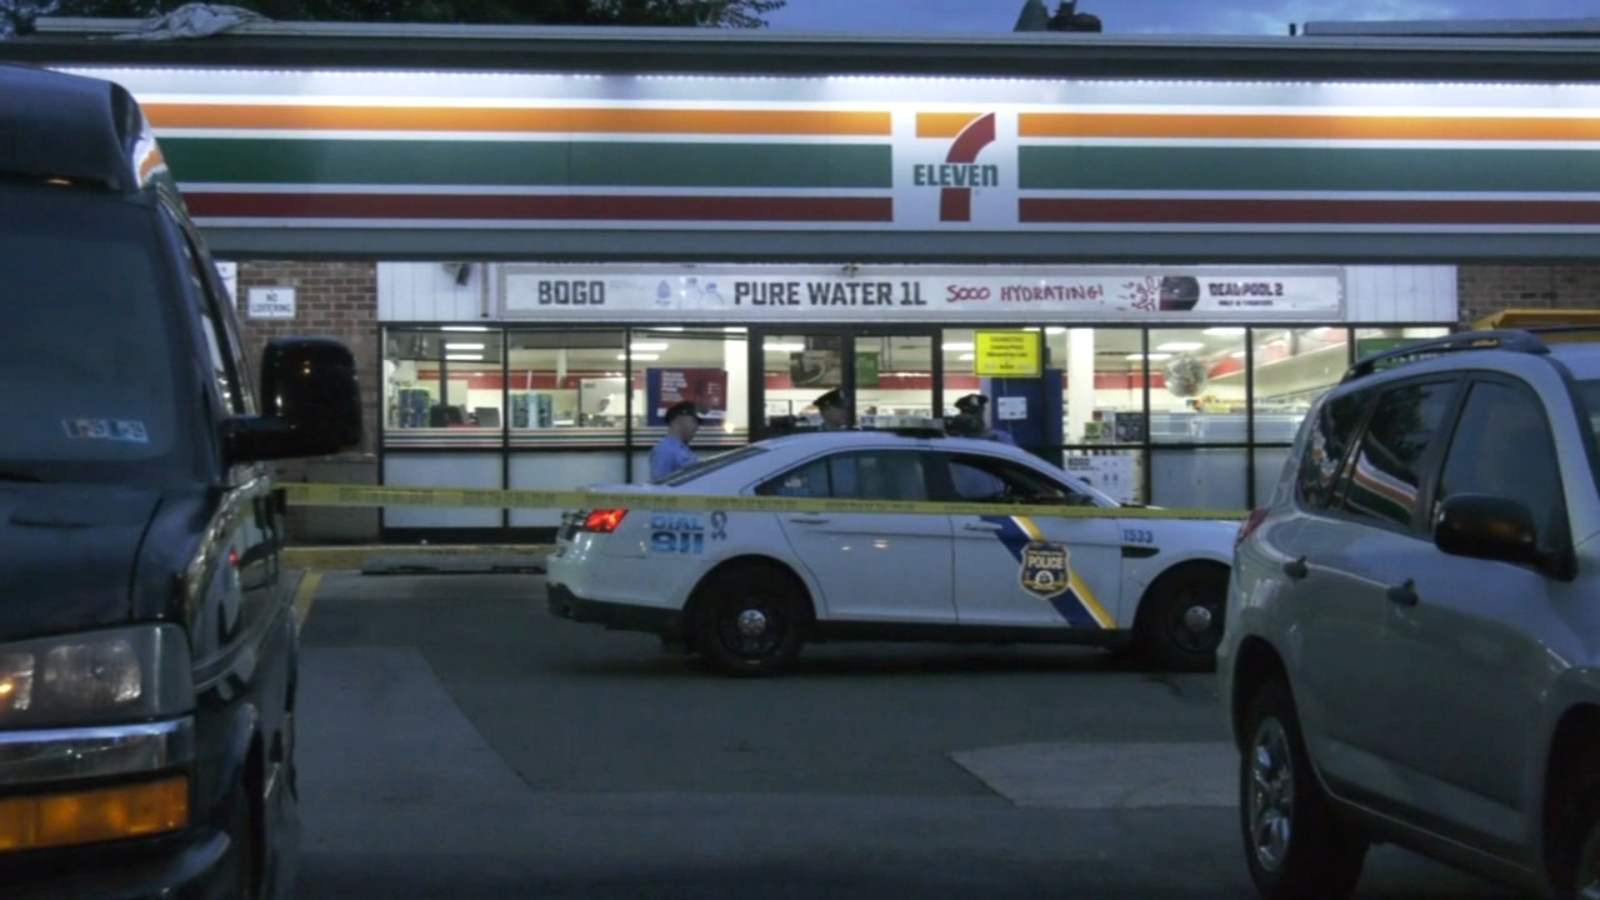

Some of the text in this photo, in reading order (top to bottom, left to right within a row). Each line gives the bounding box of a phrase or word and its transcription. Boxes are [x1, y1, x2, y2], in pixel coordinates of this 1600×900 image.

[537, 280, 605, 305] BOGO
[734, 281, 927, 306] PURE WATER 1L
[1000, 283, 1104, 305] HYDRATING!
[1274, 282, 1284, 297] 2
[650, 510, 704, 531] DIAL
[650, 531, 704, 554] 911
[1123, 529, 1154, 544] 1533
[1028, 555, 1064, 570] POLICE
